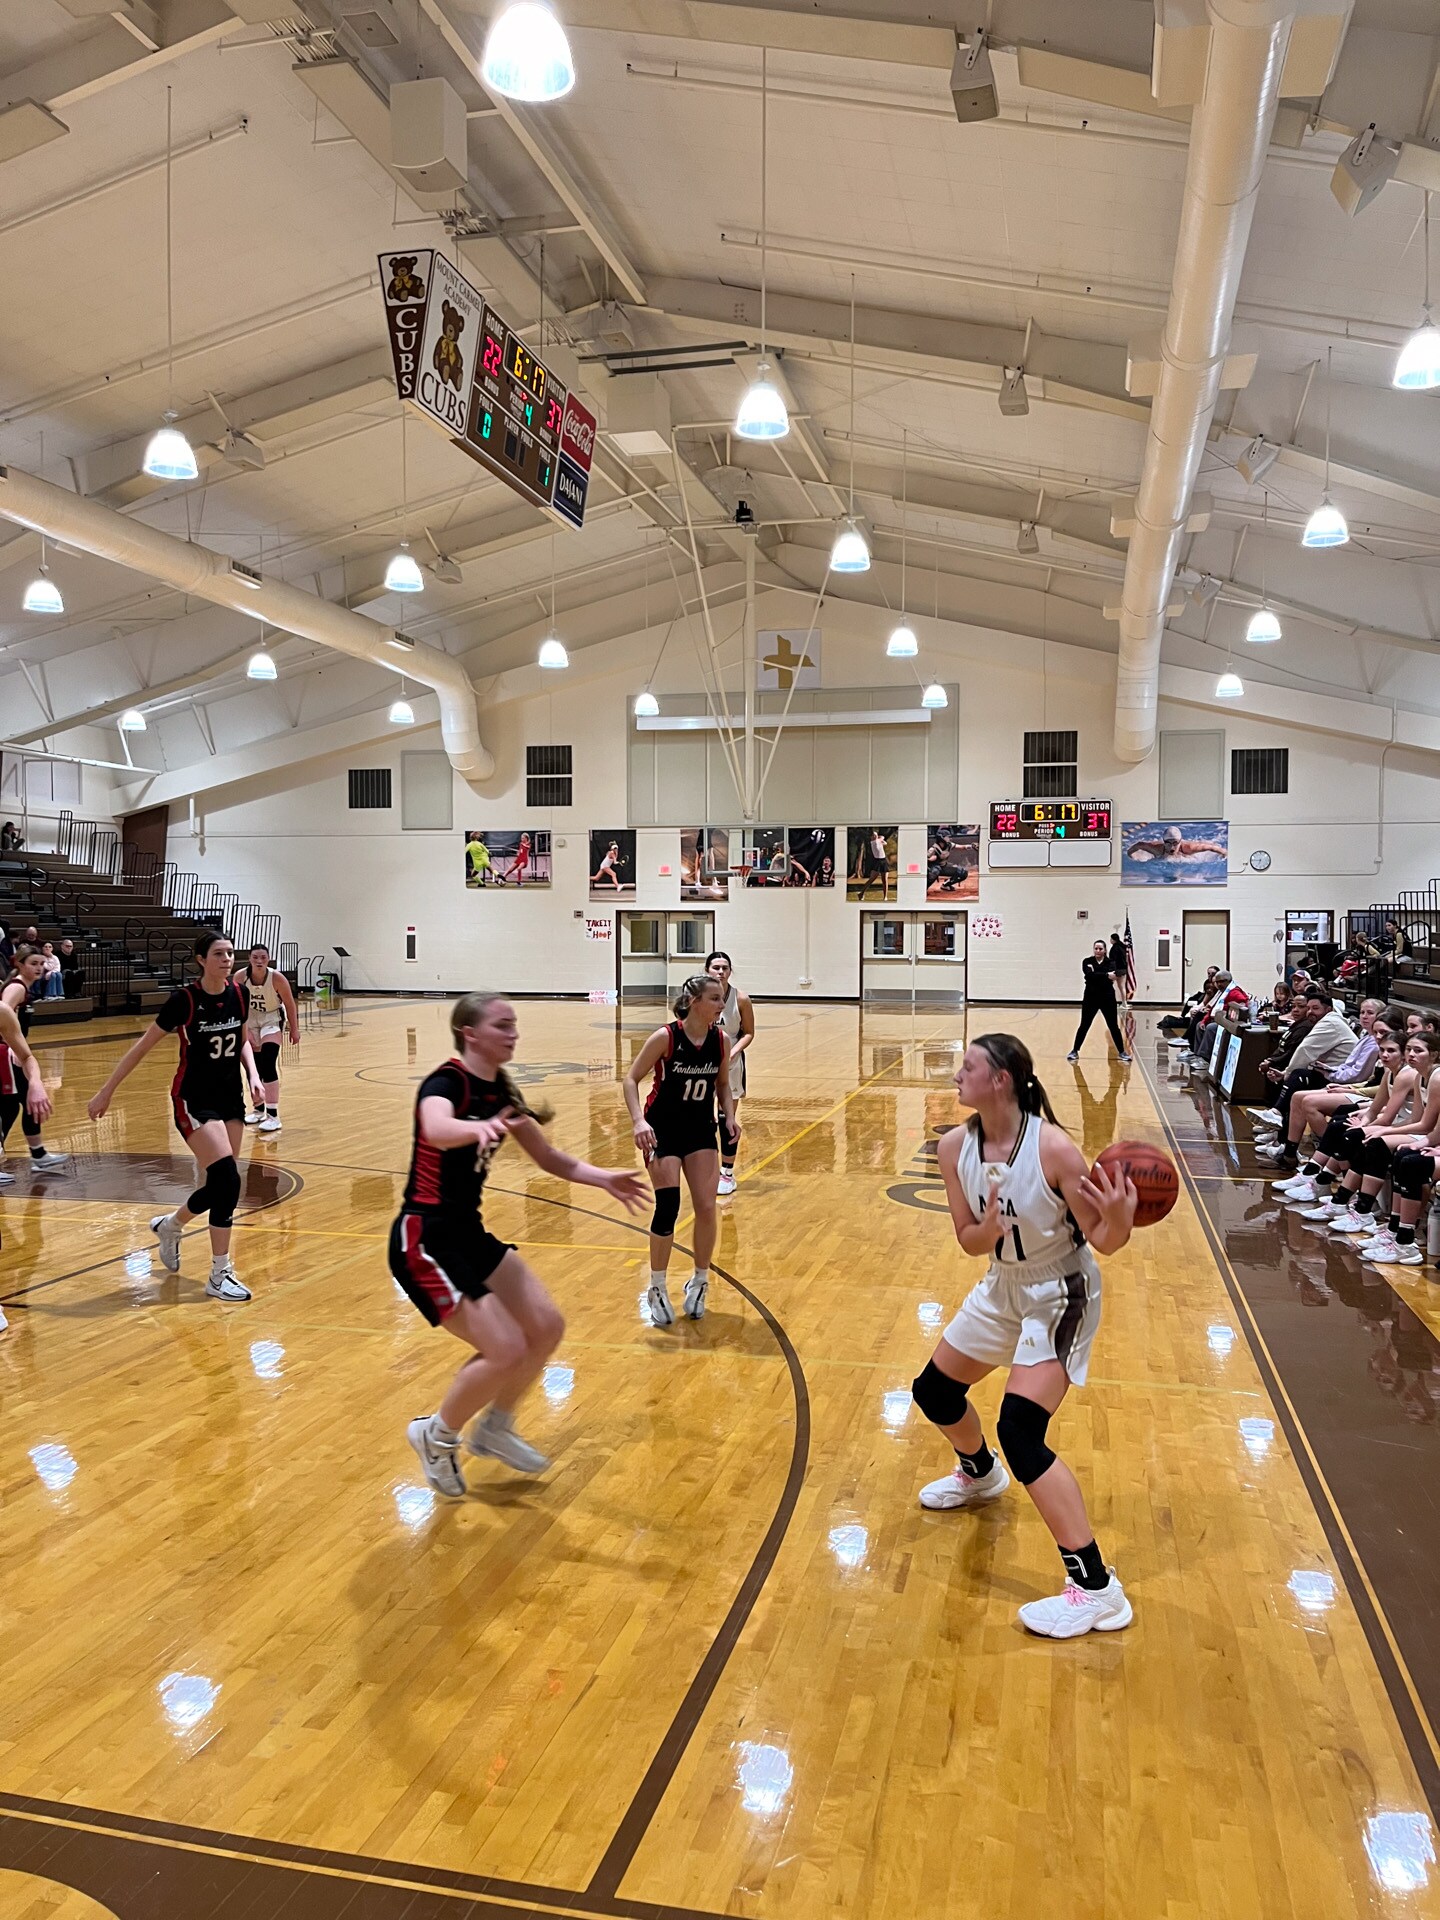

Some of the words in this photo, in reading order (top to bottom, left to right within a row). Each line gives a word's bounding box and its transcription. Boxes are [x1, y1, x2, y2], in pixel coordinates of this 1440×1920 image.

[437, 259, 458, 289] MOUNT
[459, 281, 482, 313] CARMEL
[443, 284, 472, 315] ACADEMY
[486, 312, 504, 340] HOME
[395, 308, 418, 395] CUBS
[483, 336, 502, 377] 22
[514, 345, 545, 398] 6:17
[421, 372, 466, 429] CUBS
[547, 376, 566, 402] VISITOR
[479, 394, 493, 413] FOULS
[510, 391, 525, 412] PERIOD
[525, 403, 533, 426] 4
[546, 399, 562, 434] 37
[504, 416, 519, 437] PLAYER
[520, 430, 534, 449] FOULS
[539, 447, 551, 464] FOULS
[544, 466, 550, 487] 1
[560, 473, 583, 506] DASANI
[994, 804, 1016, 812] HOME
[1035, 804, 1075, 821] 6:17
[1081, 802, 1110, 811] VISITOR
[997, 814, 1017, 831] 22
[1055, 825, 1065, 839] 4
[1087, 813, 1108, 829] 37
[593, 931, 612, 940] HOOP
[209, 1033, 237, 1059] 32
[682, 1078, 708, 1101] 10
